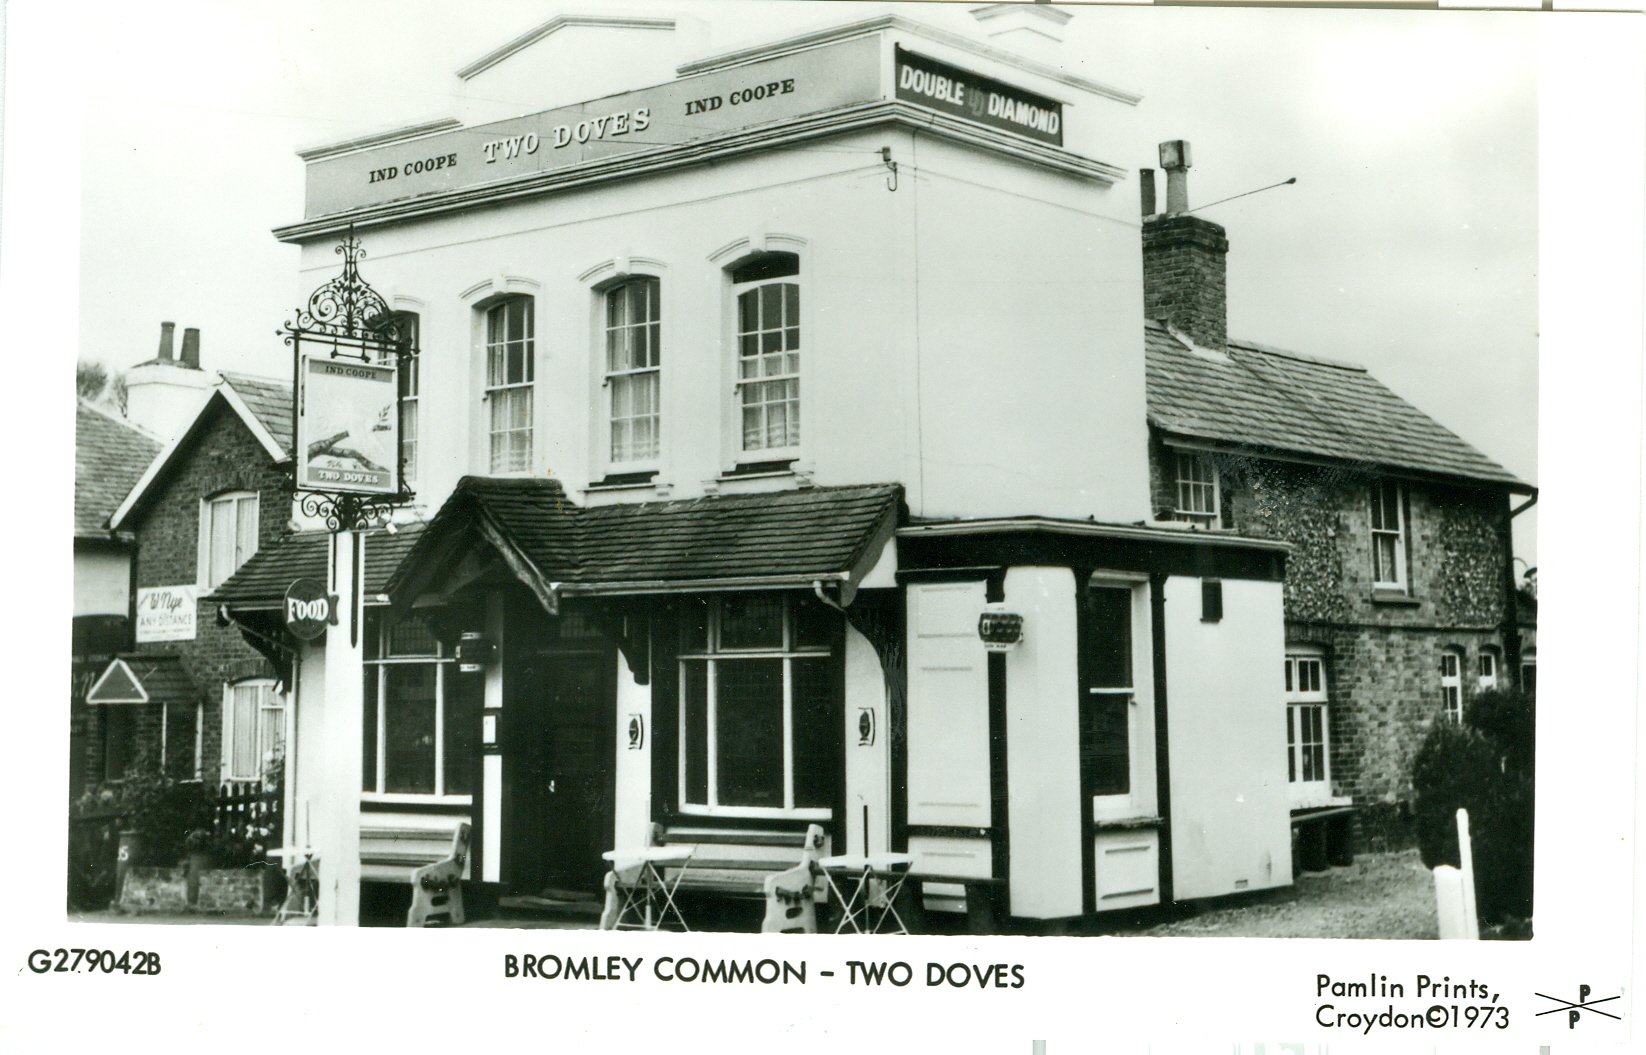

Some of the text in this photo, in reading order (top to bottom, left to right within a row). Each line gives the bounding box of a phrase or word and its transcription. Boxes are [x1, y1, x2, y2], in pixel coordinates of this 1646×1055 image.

[685, 79, 795, 116] IND COOPE
[900, 64, 965, 106] DOUBLE
[987, 92, 1060, 134] DIAMOND
[483, 108, 651, 163] TWO DOVES
[369, 153, 457, 183] IND COOPE
[325, 365, 377, 379] IND COOPE
[318, 470, 379, 484] TWO DOVES
[287, 597, 329, 623] FOOD
